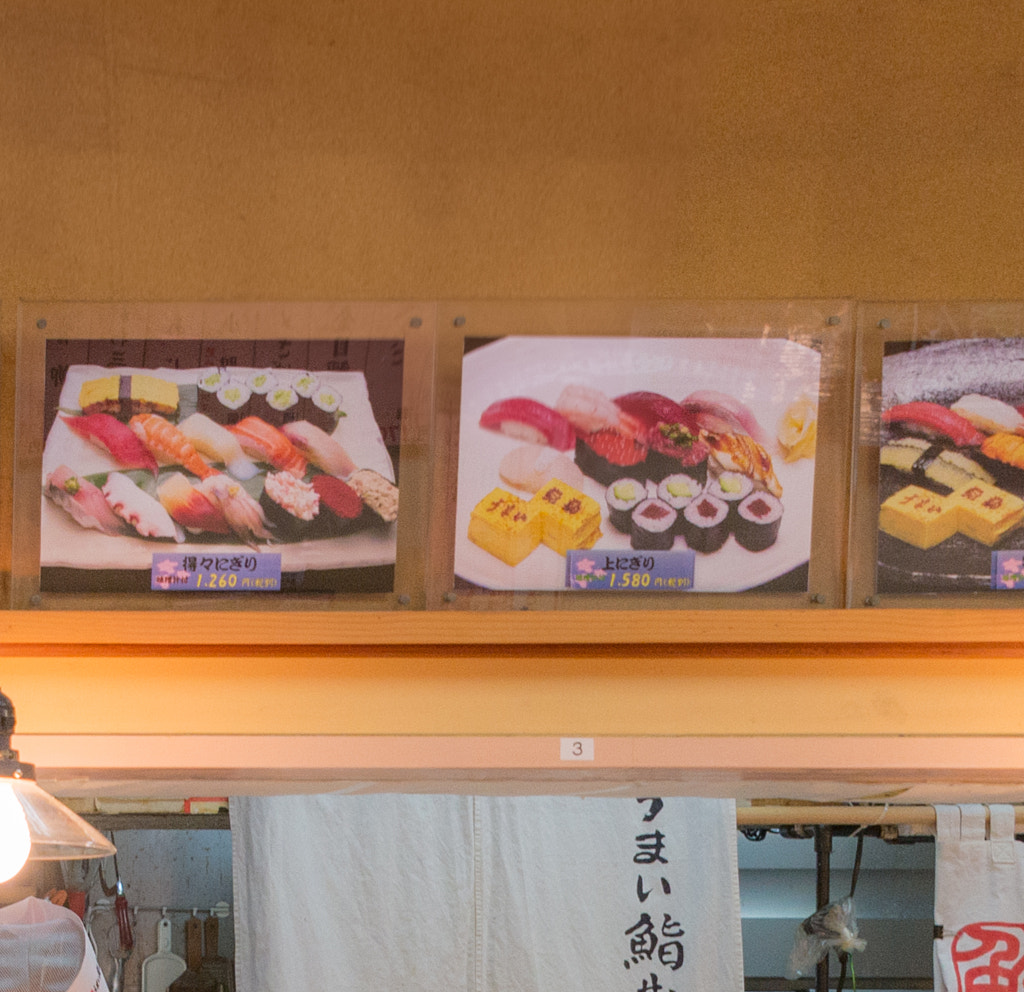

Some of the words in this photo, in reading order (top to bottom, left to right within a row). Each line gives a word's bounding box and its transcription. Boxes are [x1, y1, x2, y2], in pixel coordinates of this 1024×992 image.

[182, 556, 257, 572] 得々にぎり
[603, 556, 655, 571] 上にぎり
[572, 741, 584, 756] 3
